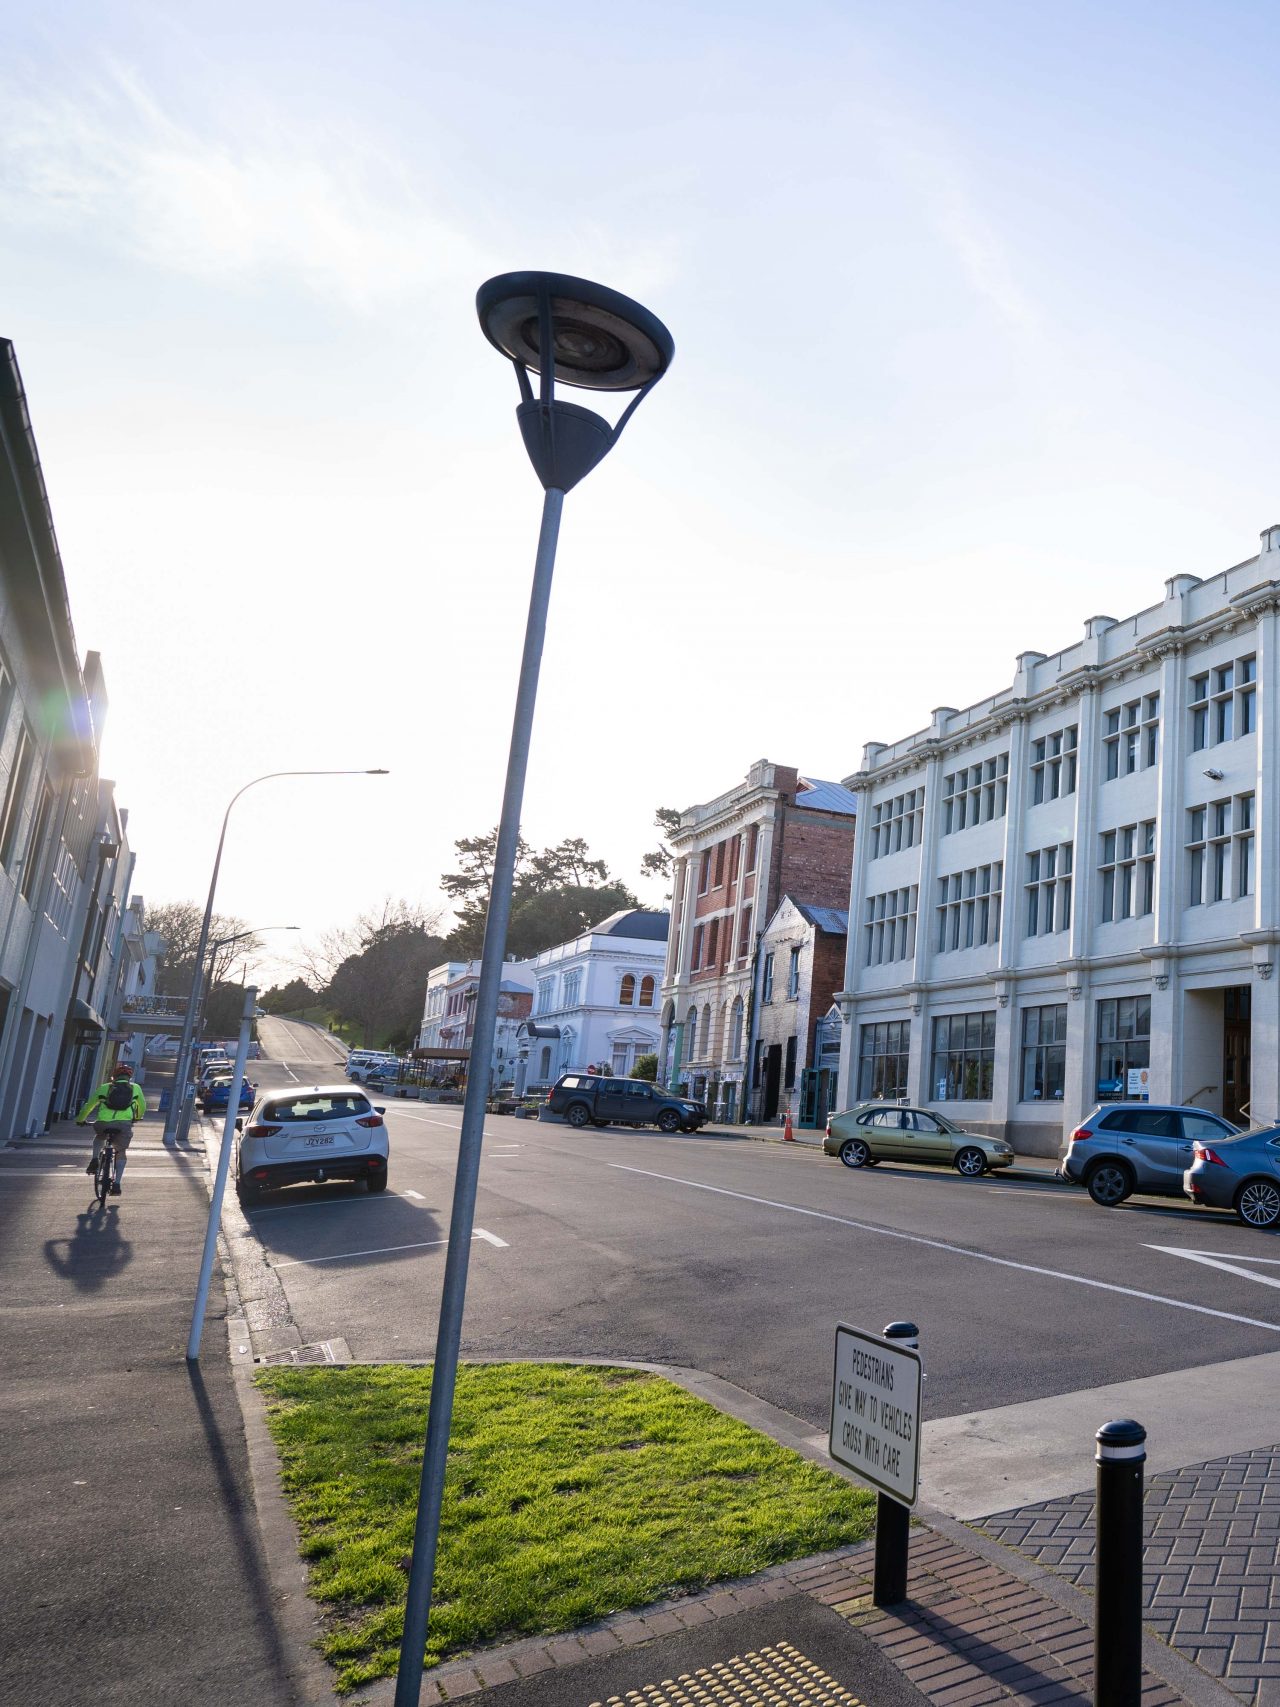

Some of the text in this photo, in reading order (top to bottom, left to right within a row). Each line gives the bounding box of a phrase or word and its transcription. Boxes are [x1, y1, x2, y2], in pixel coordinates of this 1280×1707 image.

[853, 1349, 894, 1391] PEDESTRIANS
[839, 1380, 912, 1441] GIVE WAY TO VEHICLES
[843, 1421, 900, 1477] CROSS WITH CARE
